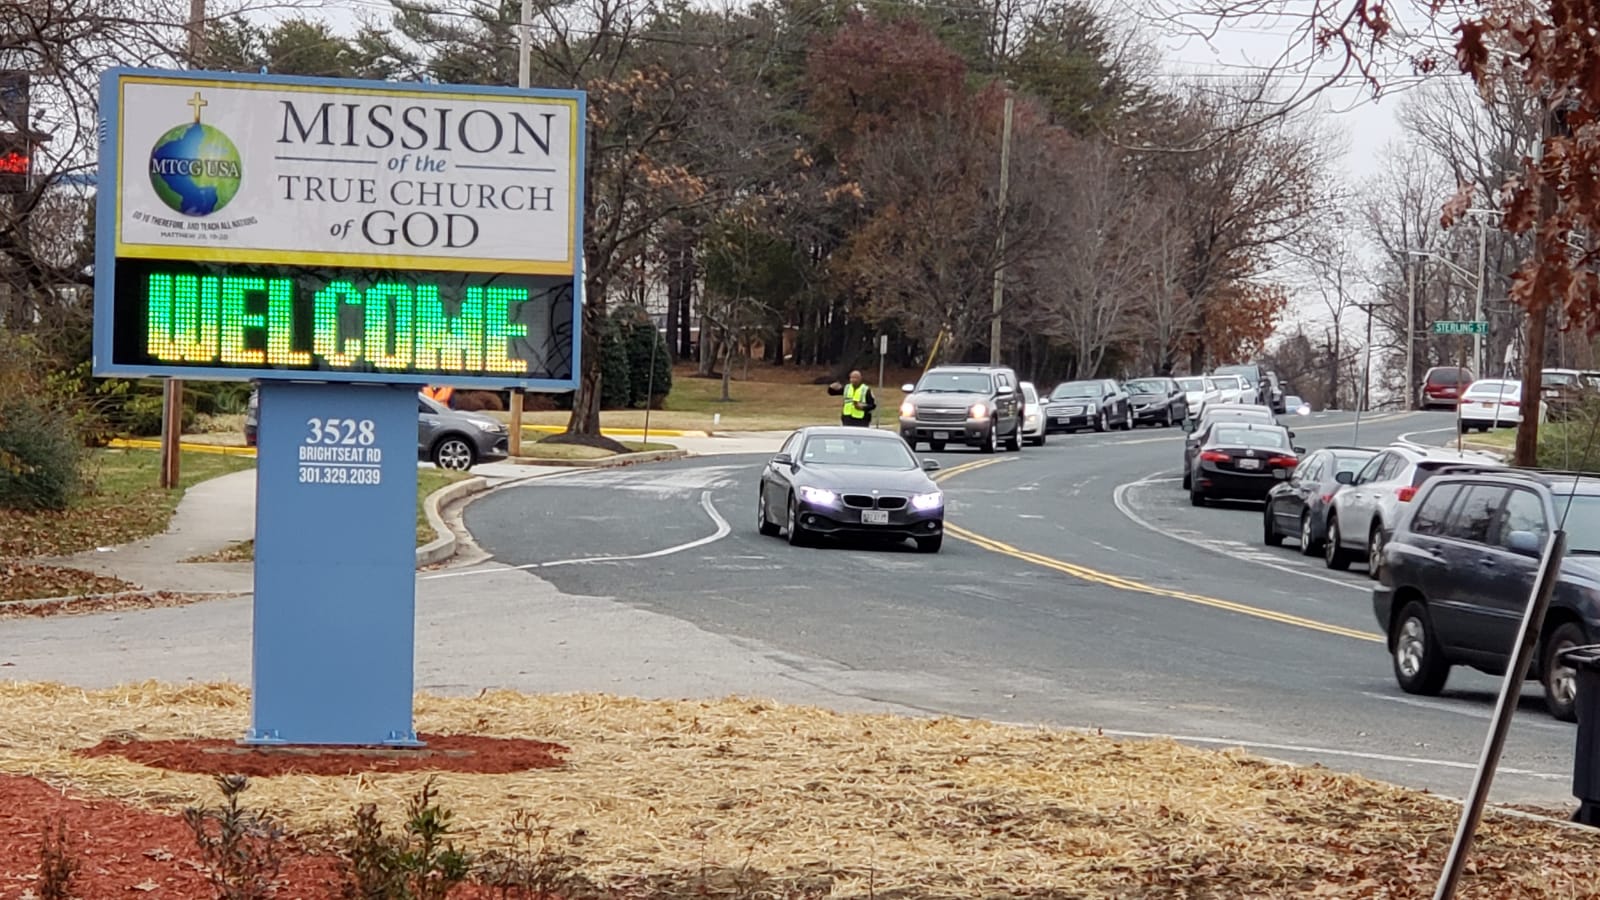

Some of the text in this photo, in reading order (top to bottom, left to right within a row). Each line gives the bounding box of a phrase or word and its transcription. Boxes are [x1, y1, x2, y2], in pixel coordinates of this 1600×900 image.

[276, 99, 556, 156] MISSION
[151, 158, 240, 177] MTCG USA
[387, 153, 446, 174] of the
[277, 174, 555, 212] TRUE CHURCH
[201, 222, 220, 231] TEACH
[221, 221, 231, 230] ALL
[330, 209, 479, 248] of GOD
[147, 272, 529, 374] WELCOME
[1436, 323, 1486, 332] STERLING ST
[306, 418, 375, 445] 3528
[299, 446, 381, 462] BRIGHTSEAT RD
[299, 467, 381, 485] 301.329.2039
